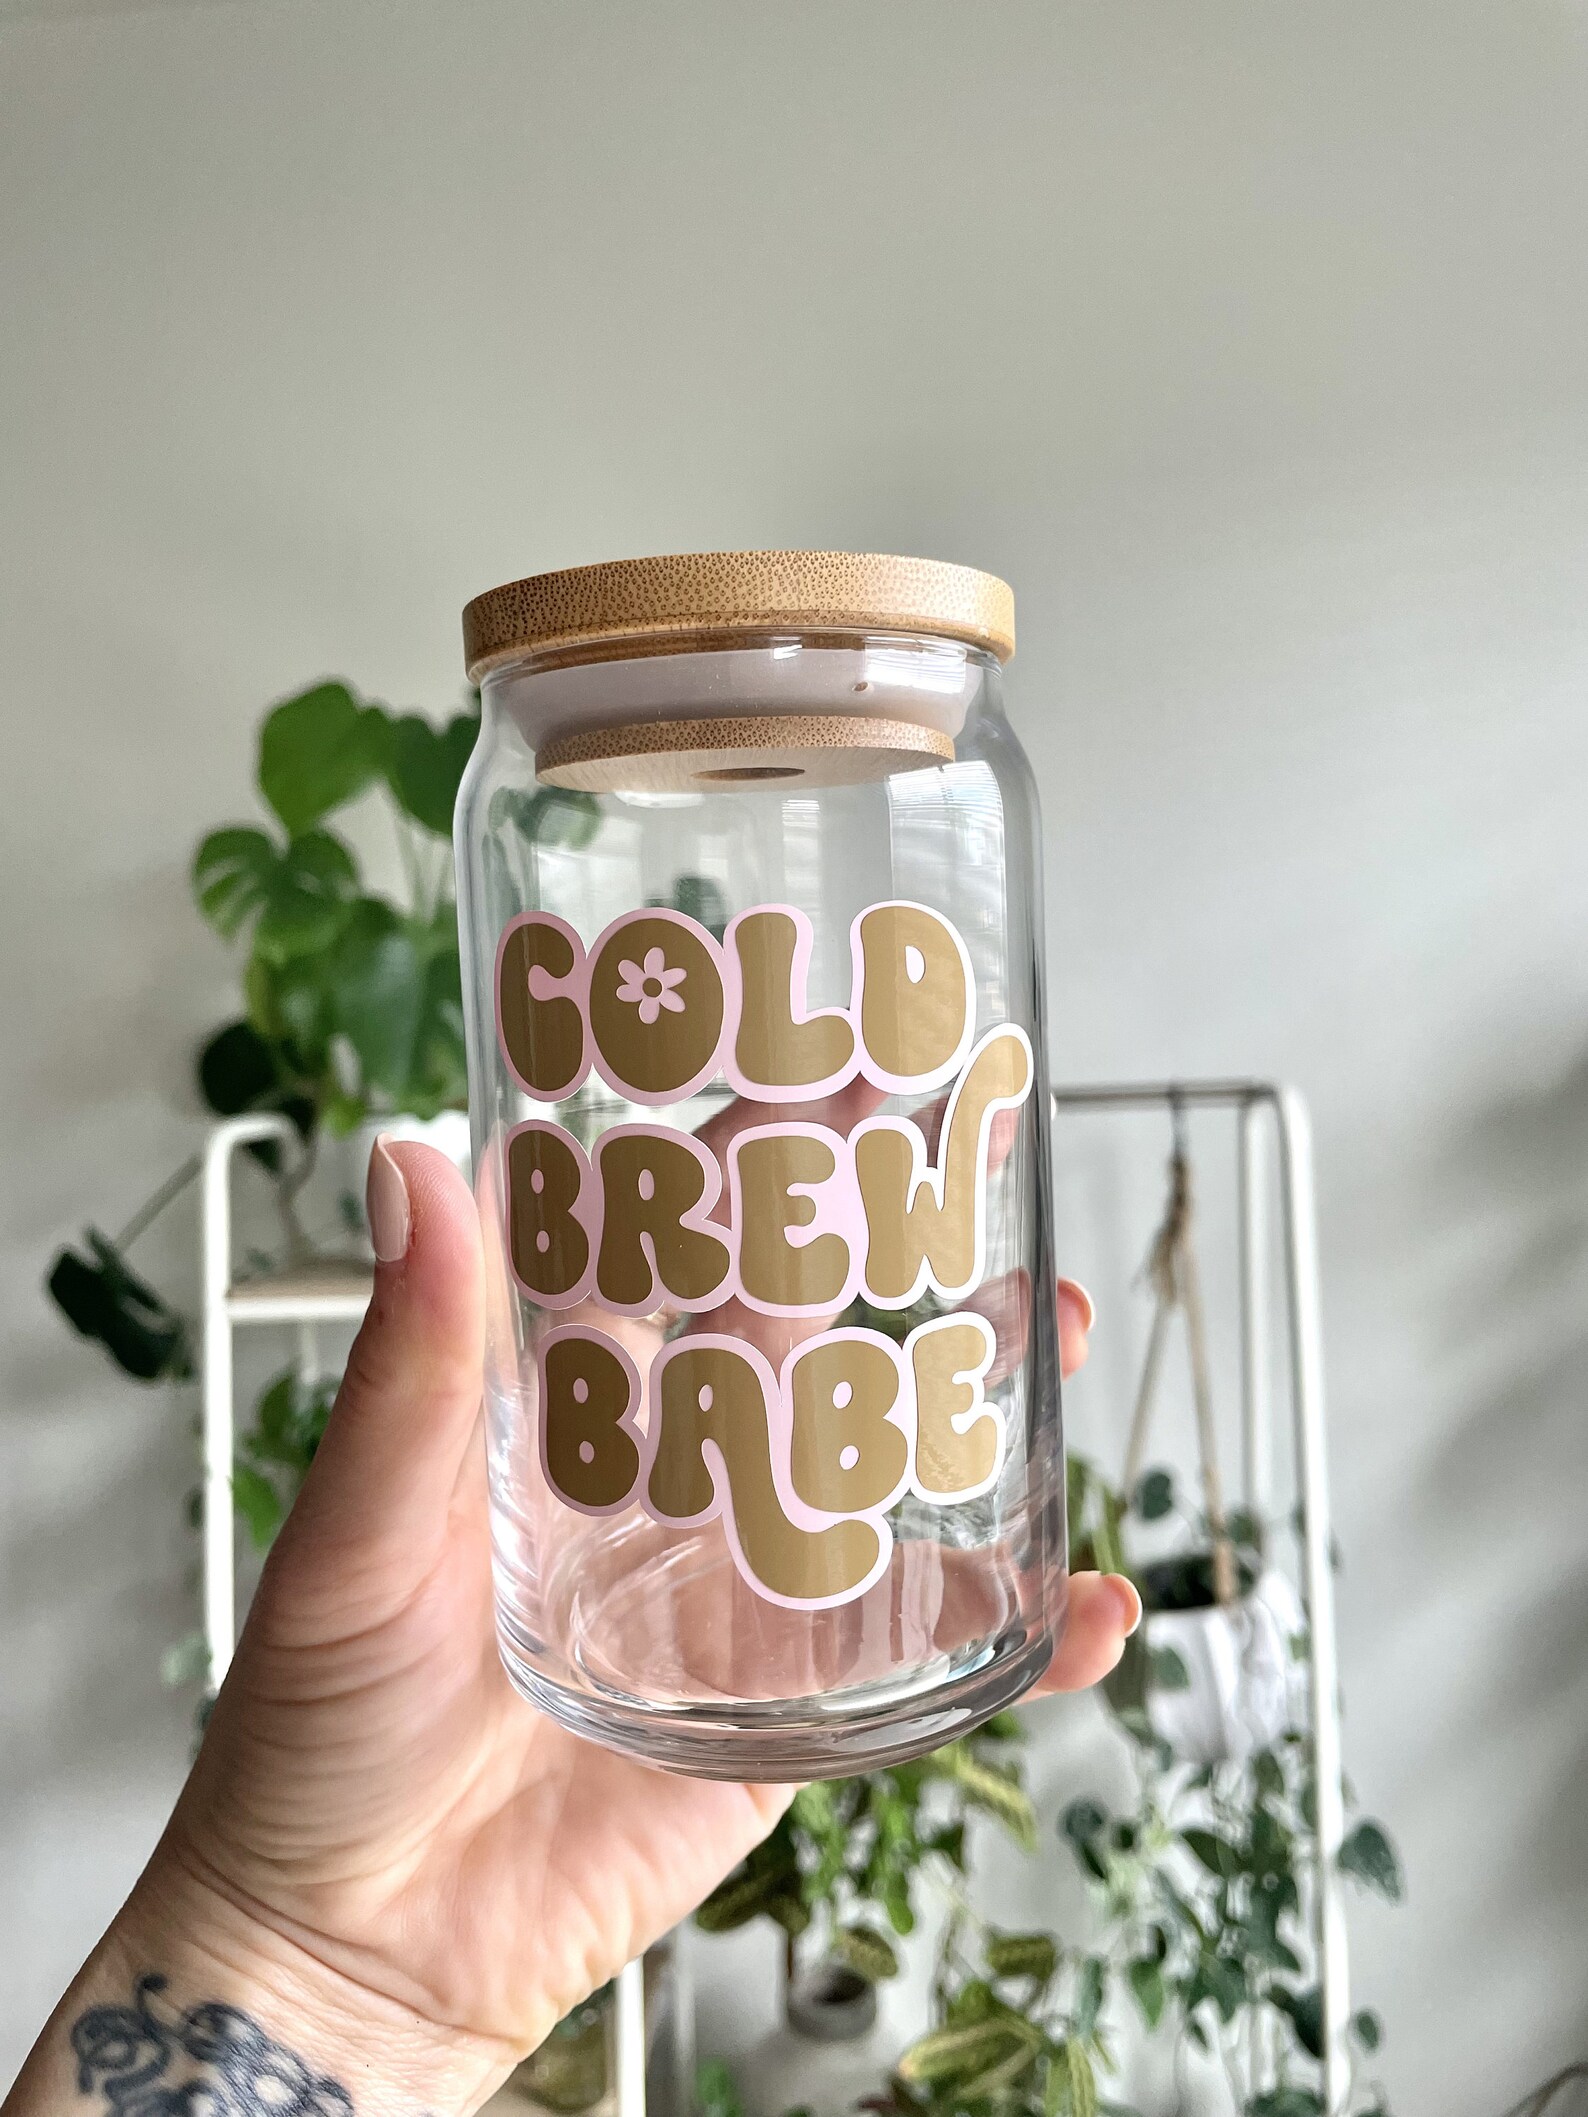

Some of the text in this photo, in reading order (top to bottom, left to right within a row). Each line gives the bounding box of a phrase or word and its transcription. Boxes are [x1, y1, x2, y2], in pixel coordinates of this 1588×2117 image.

[495, 902, 975, 1104] COLD
[503, 1024, 1033, 1316] BREW
[540, 1313, 1004, 1610] BABE
